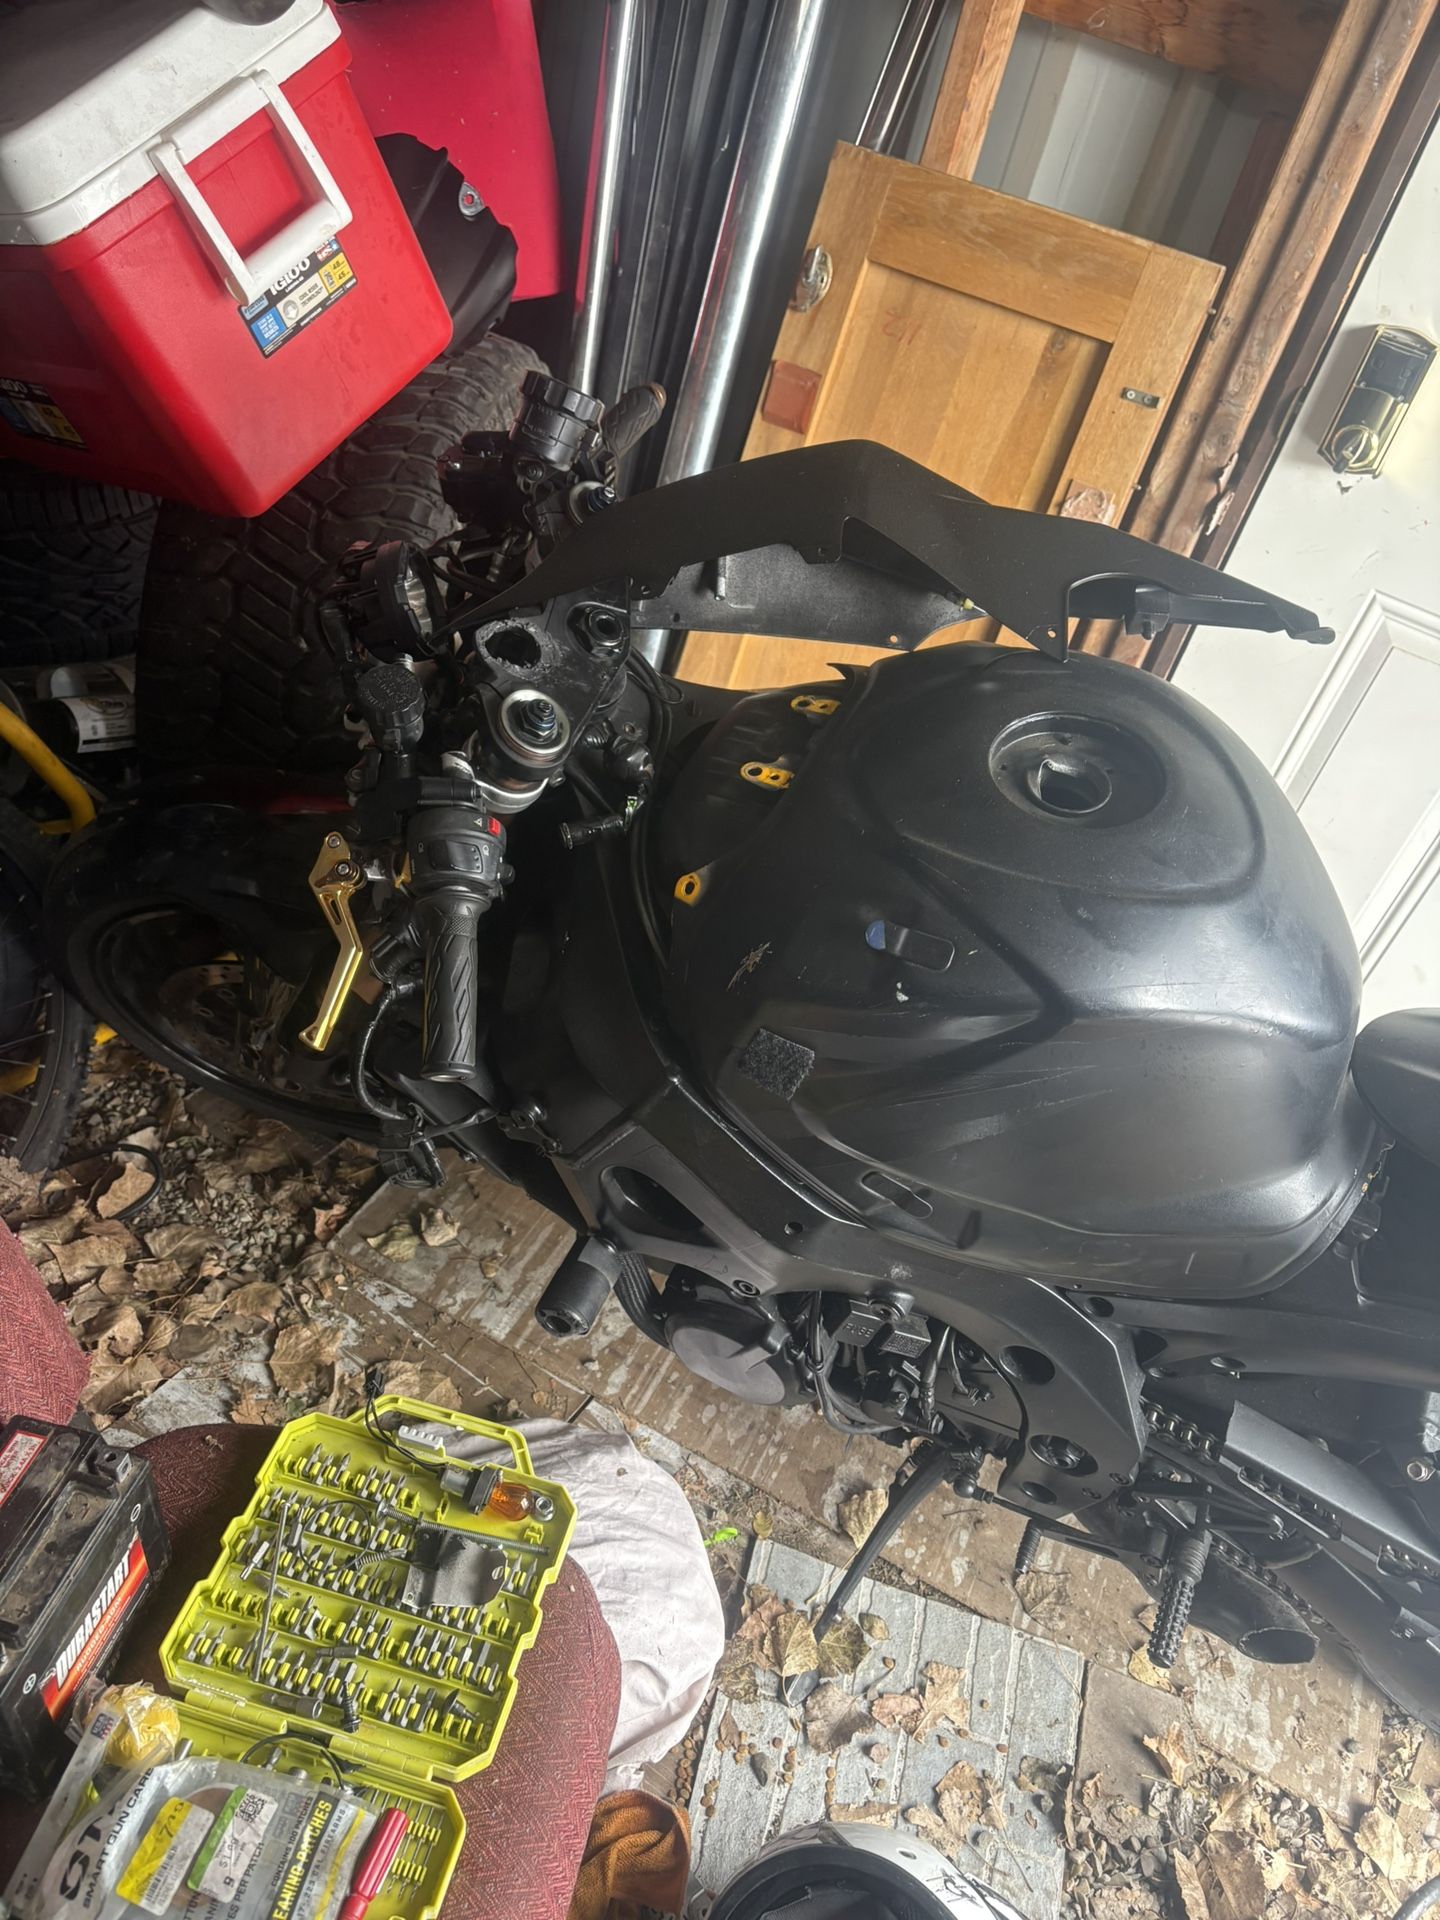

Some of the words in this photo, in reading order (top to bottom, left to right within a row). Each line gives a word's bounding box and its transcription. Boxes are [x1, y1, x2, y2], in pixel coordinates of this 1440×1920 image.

[269, 257, 311, 296] IGLOO
[55, 1550, 130, 1688] DURASTART
[82, 1851, 110, 1908] SMART
[106, 1811, 130, 1845] GUN
[271, 1846, 292, 1887] CONTAINS
[287, 1829, 298, 1847] 100
[296, 1796, 314, 1831] PATCHES
[296, 1800, 333, 1862] PATCHES
[233, 1880, 249, 1903] PER
[245, 1842, 265, 1878] PATCH
